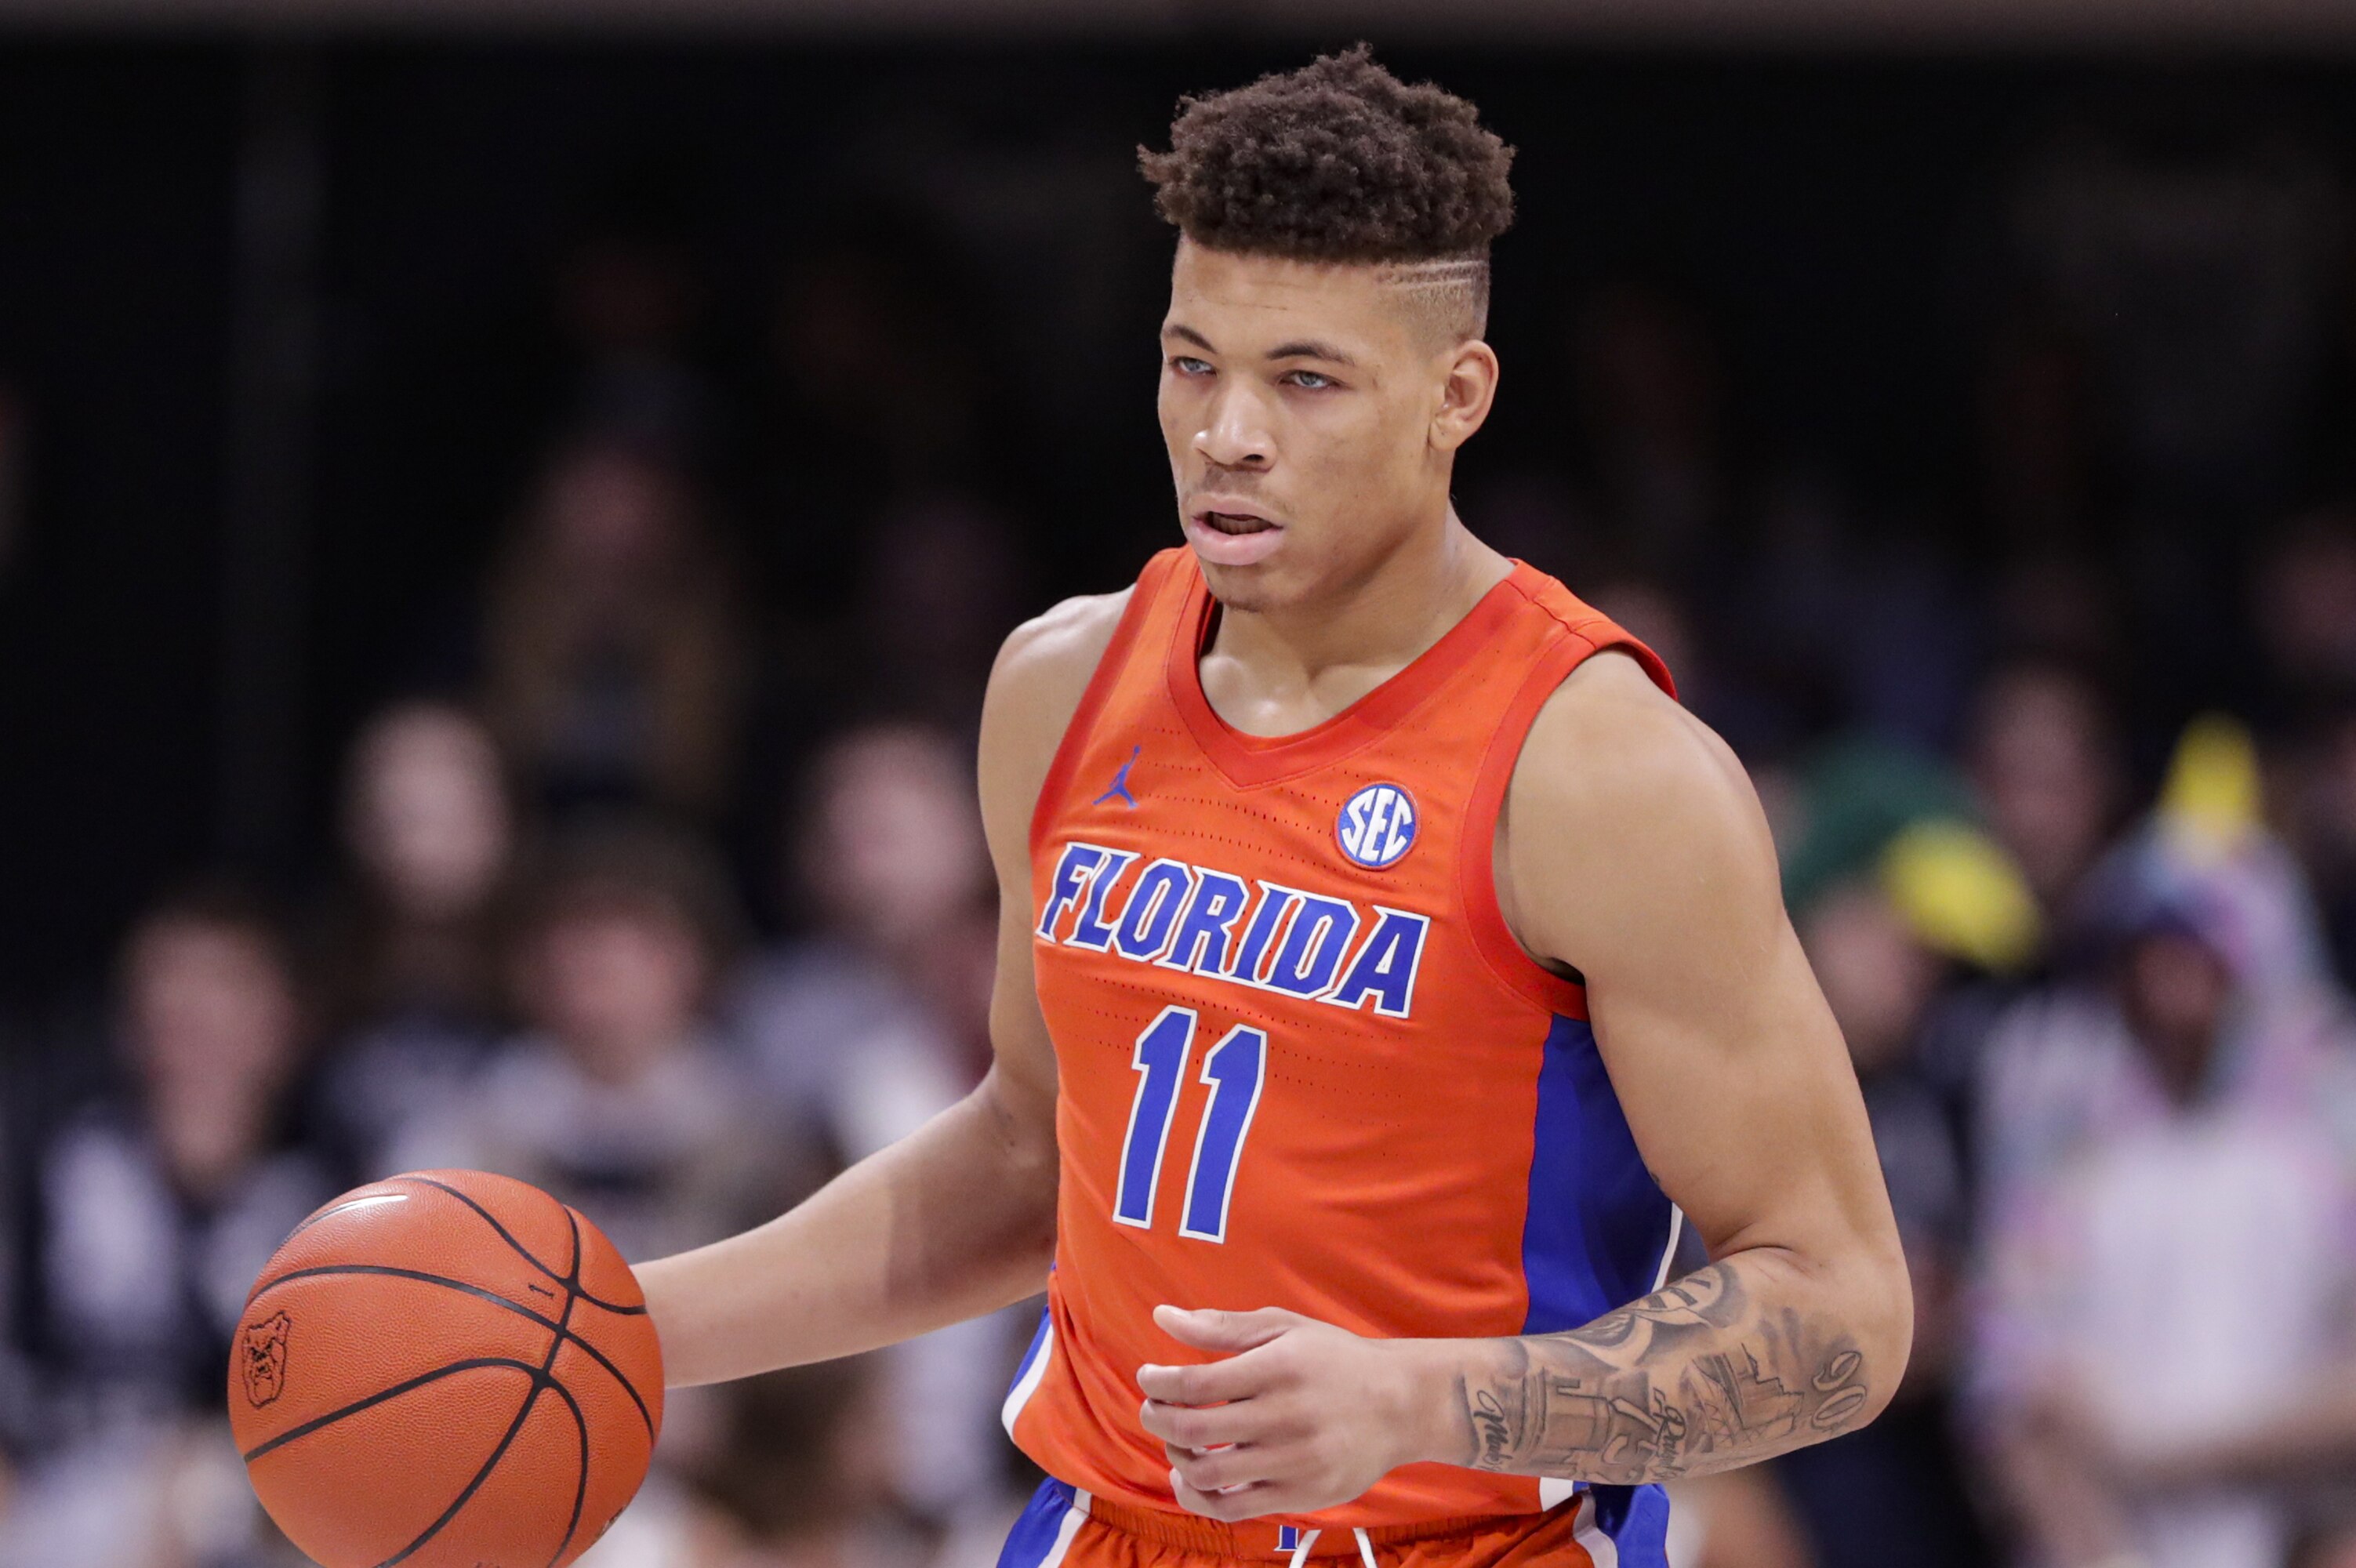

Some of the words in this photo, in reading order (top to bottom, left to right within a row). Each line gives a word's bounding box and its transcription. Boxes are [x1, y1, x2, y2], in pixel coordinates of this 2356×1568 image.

[1341, 786, 1412, 863] SEC
[1035, 842, 1431, 1018] FLORIDA
[1112, 1004, 1268, 1245] 11
